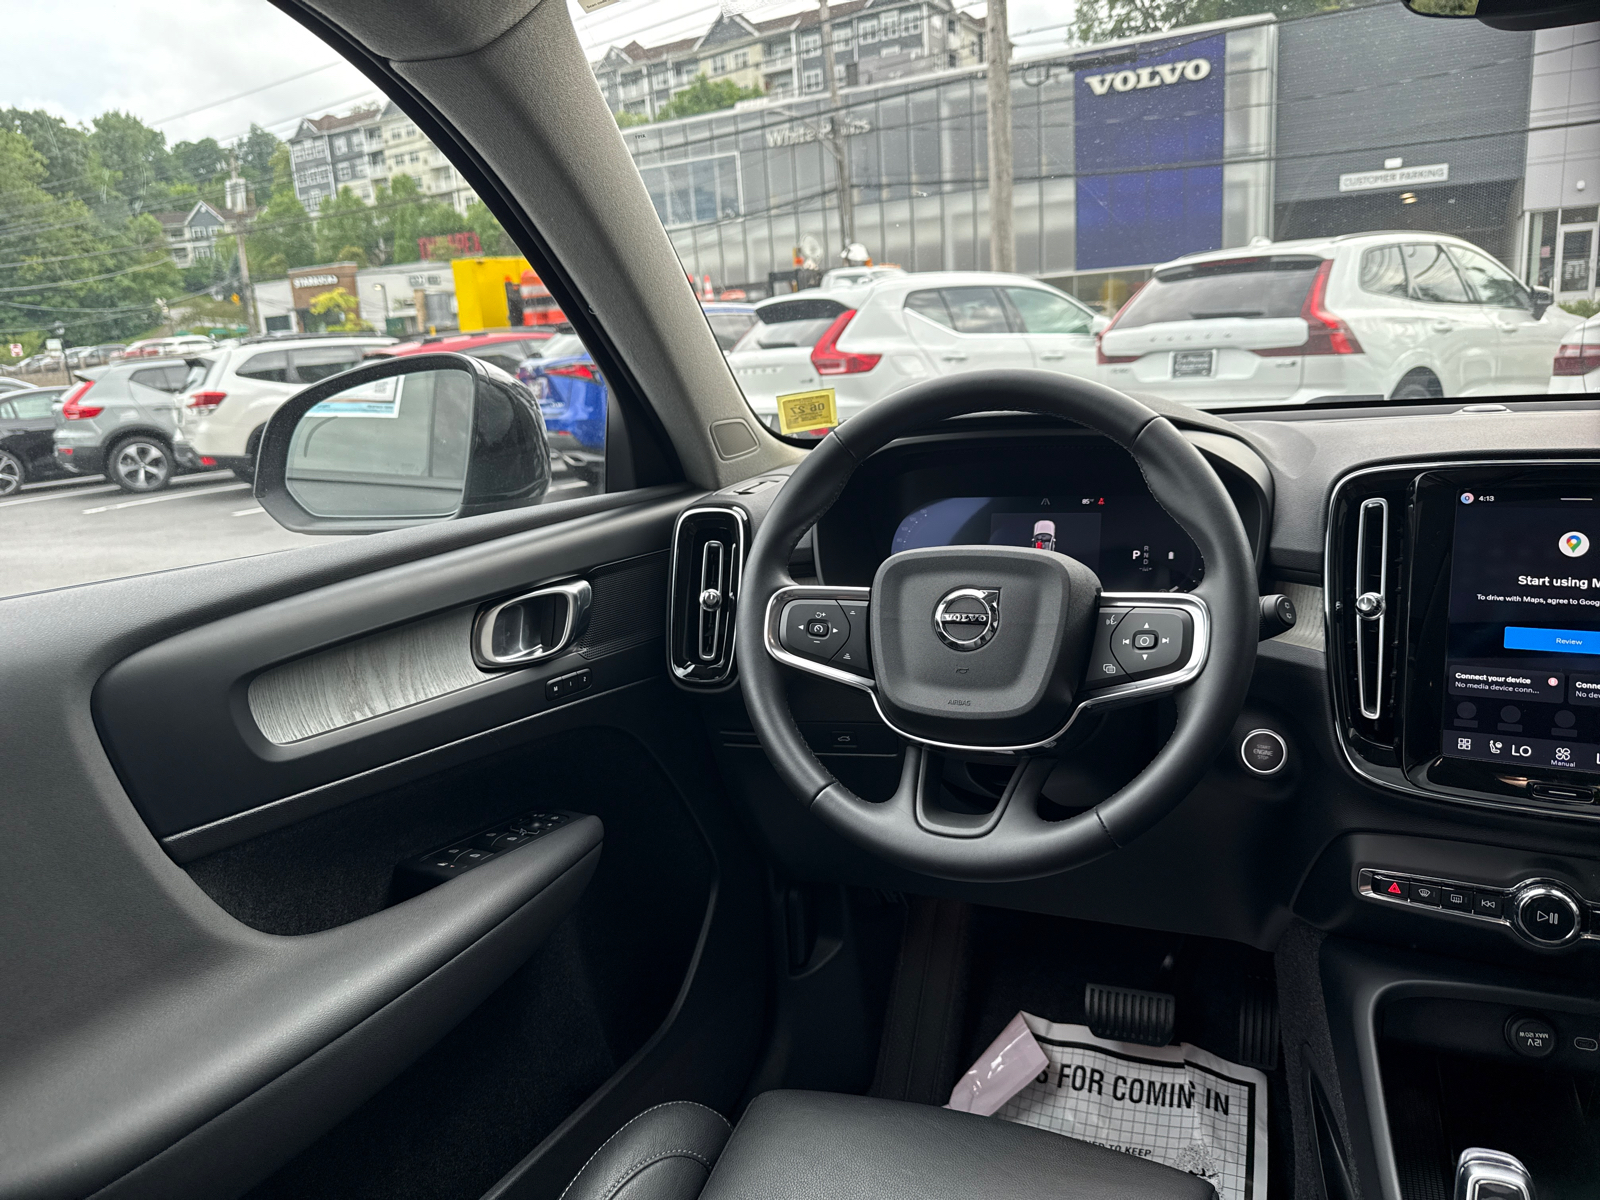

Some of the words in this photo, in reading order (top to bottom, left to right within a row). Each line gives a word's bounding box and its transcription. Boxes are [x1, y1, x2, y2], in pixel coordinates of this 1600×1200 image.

[1084, 58, 1211, 96] VOLVO
[766, 126, 816, 147] White
[1343, 172, 1397, 187] CUSTOMER
[1399, 168, 1445, 181] PARKING
[1132, 550, 1141, 560] P
[1518, 575, 1550, 586] Start
[1553, 577, 1588, 589] using
[1476, 593, 1486, 601] To
[1487, 594, 1504, 602] drive
[1523, 596, 1546, 604] Maps,
[1547, 598, 1568, 606] agree
[943, 613, 987, 622] VOLVO
[1555, 637, 1583, 646] Review
[1455, 672, 1487, 682] Connect
[1488, 675, 1505, 683] your
[1506, 676, 1531, 684] device
[1490, 684, 1513, 692] device
[1575, 690, 1587, 698] No
[947, 699, 971, 707] AIRBAG
[1511, 744, 1531, 756] LO
[1551, 759, 1576, 768] Manual
[1057, 1063, 1104, 1096] FOR
[1205, 1087, 1230, 1117] IN
[1125, 1145, 1152, 1157] KEEP
